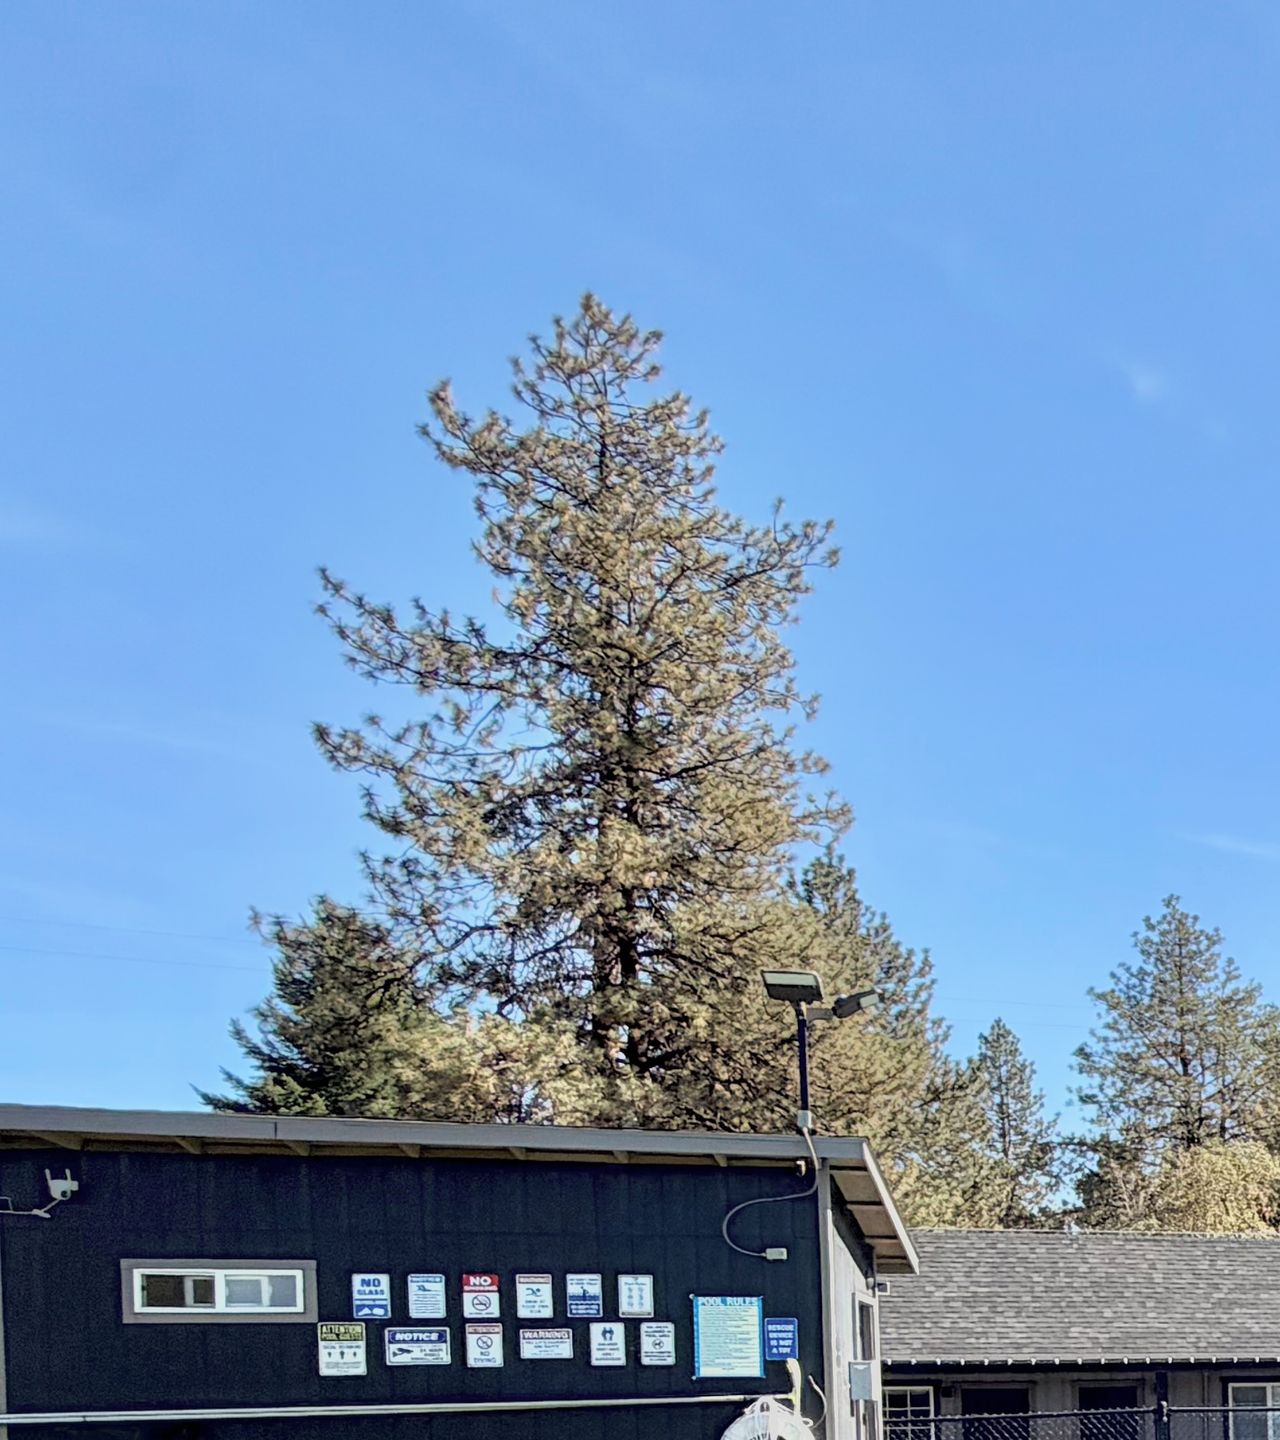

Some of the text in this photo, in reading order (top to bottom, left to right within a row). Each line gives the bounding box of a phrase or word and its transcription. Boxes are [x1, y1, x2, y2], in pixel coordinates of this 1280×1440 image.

[361, 1278, 381, 1288] NO
[469, 1276, 492, 1286] NO
[698, 1296, 721, 1306] POOL
[395, 1332, 439, 1341] NOTICE
[523, 1331, 569, 1339] WARNING
